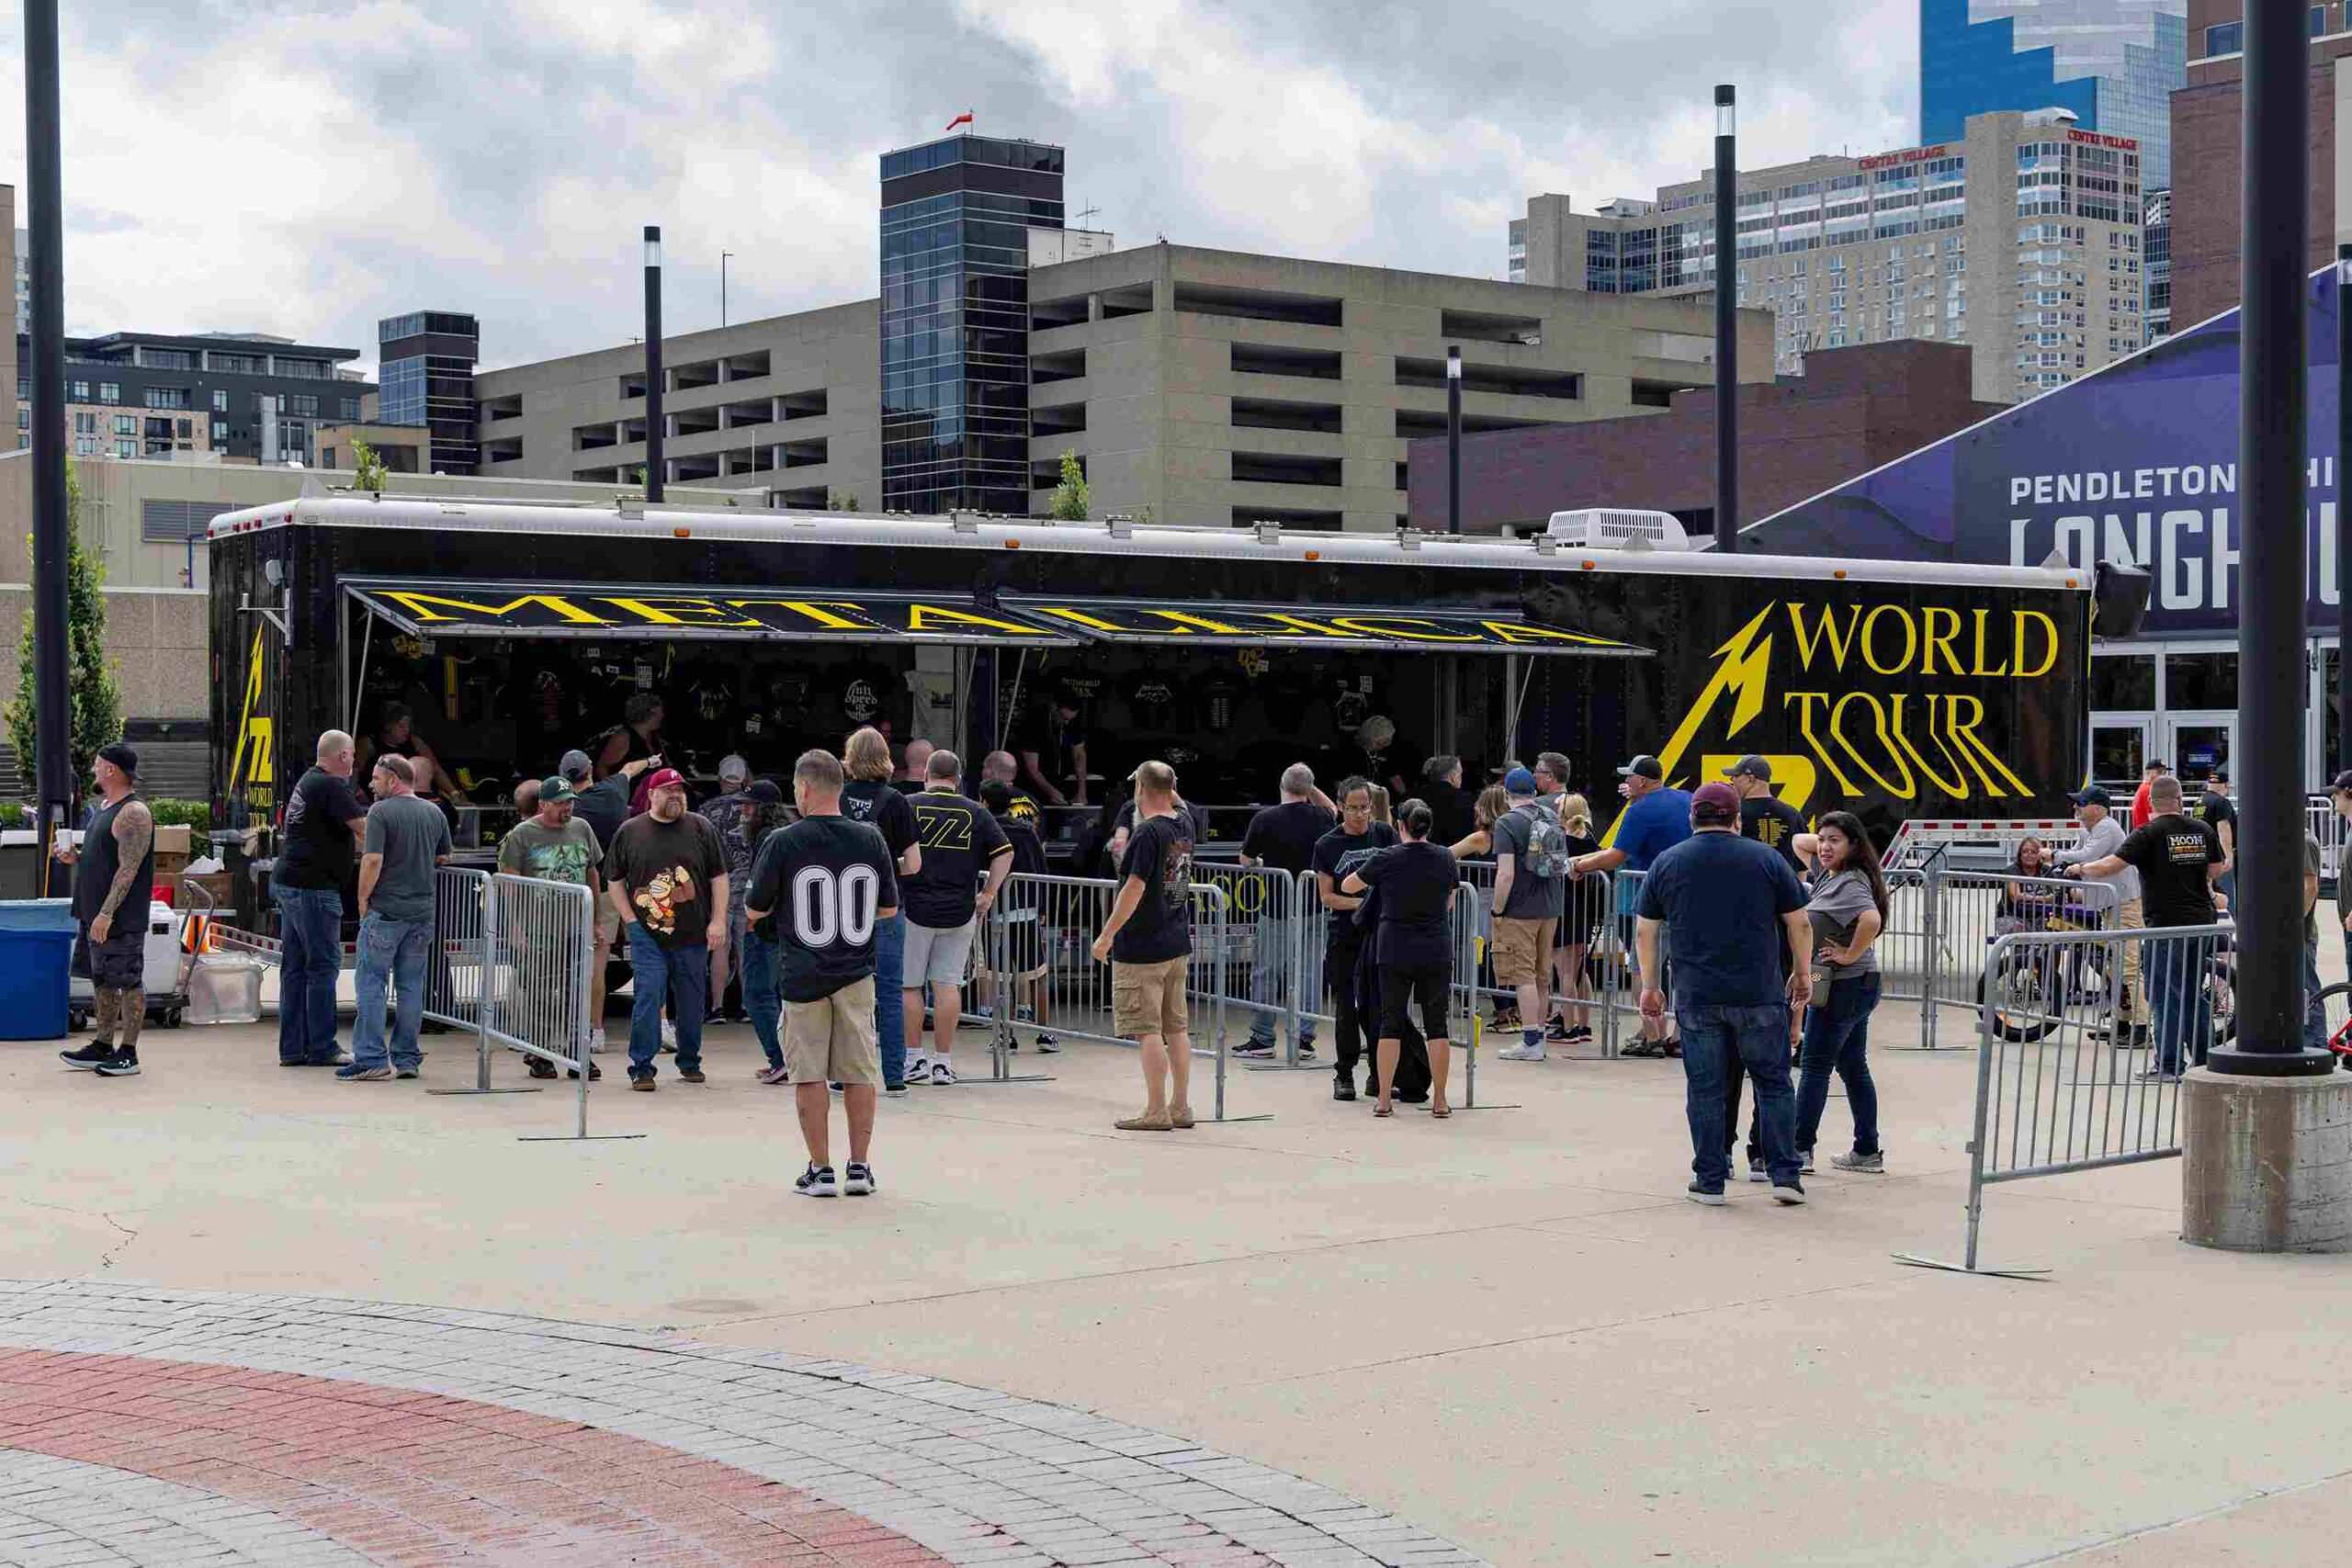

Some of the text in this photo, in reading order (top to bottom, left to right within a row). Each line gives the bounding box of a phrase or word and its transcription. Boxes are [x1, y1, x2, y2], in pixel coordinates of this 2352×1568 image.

[1859, 146, 1946, 170] CENTRE VILLAGE
[2067, 130, 2137, 151] CENTRE VILLAGE
[2009, 463, 2236, 505] PENDLETON
[1786, 604, 2059, 677] WORLD
[1784, 692, 2036, 800] TOUR
[249, 787, 272, 807] WORLD
[916, 806, 972, 850] 72
[2169, 835, 2203, 846] MOON
[793, 863, 880, 948] 00
